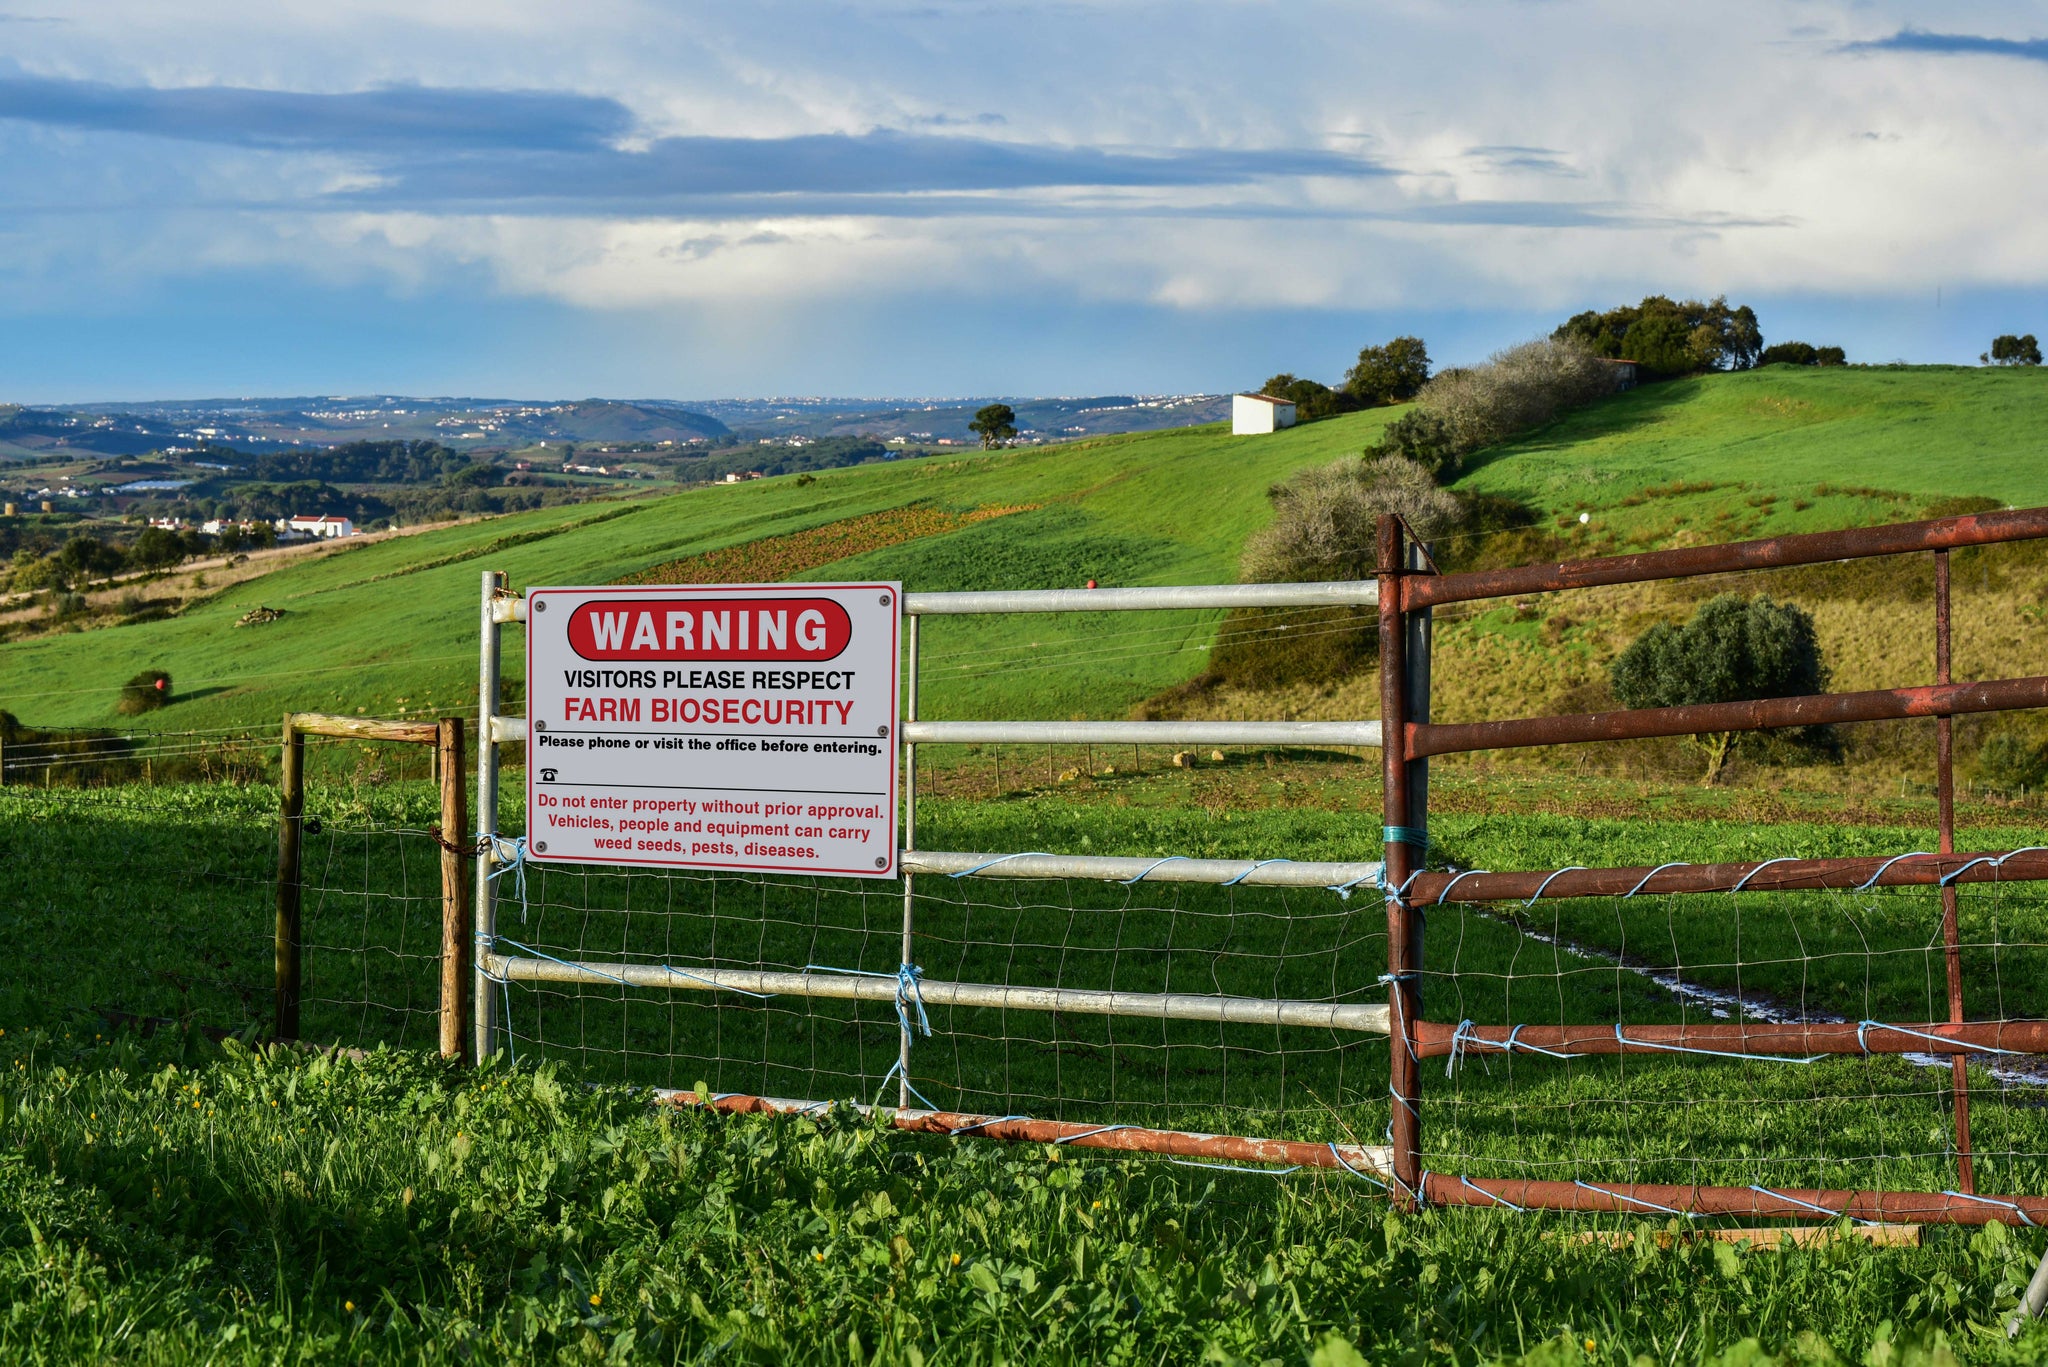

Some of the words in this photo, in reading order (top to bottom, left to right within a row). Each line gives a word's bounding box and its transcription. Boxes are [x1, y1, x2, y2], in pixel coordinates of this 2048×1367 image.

[590, 609, 826, 650] WARNING
[564, 670, 656, 688] VISITORS
[664, 671, 745, 689] PLEASE
[753, 671, 855, 690] RESPECT
[565, 698, 640, 721] FARM
[652, 699, 854, 725] BIOSECURITY
[540, 736, 584, 747] Please
[589, 737, 630, 750] phone
[635, 740, 649, 748] or
[653, 738, 683, 749] visit
[688, 739, 711, 750] the
[716, 739, 756, 751] office
[762, 740, 808, 752] before
[814, 741, 881, 756] entering.
[539, 794, 557, 806] Do
[563, 796, 585, 807] not
[590, 797, 628, 809] enter
[633, 800, 696, 815] property
[702, 800, 759, 814] without
[765, 802, 803, 818] prior
[808, 805, 883, 820] approval.
[549, 814, 613, 831] Vehicles,
[620, 818, 669, 834] people
[674, 820, 701, 832] and
[707, 821, 789, 838] equipment
[795, 827, 822, 837] can
[829, 828, 870, 843] carry
[594, 837, 631, 849] weed
[638, 839, 686, 854] seeds,
[692, 842, 738, 856] pests,
[744, 842, 819, 858] diseases.
